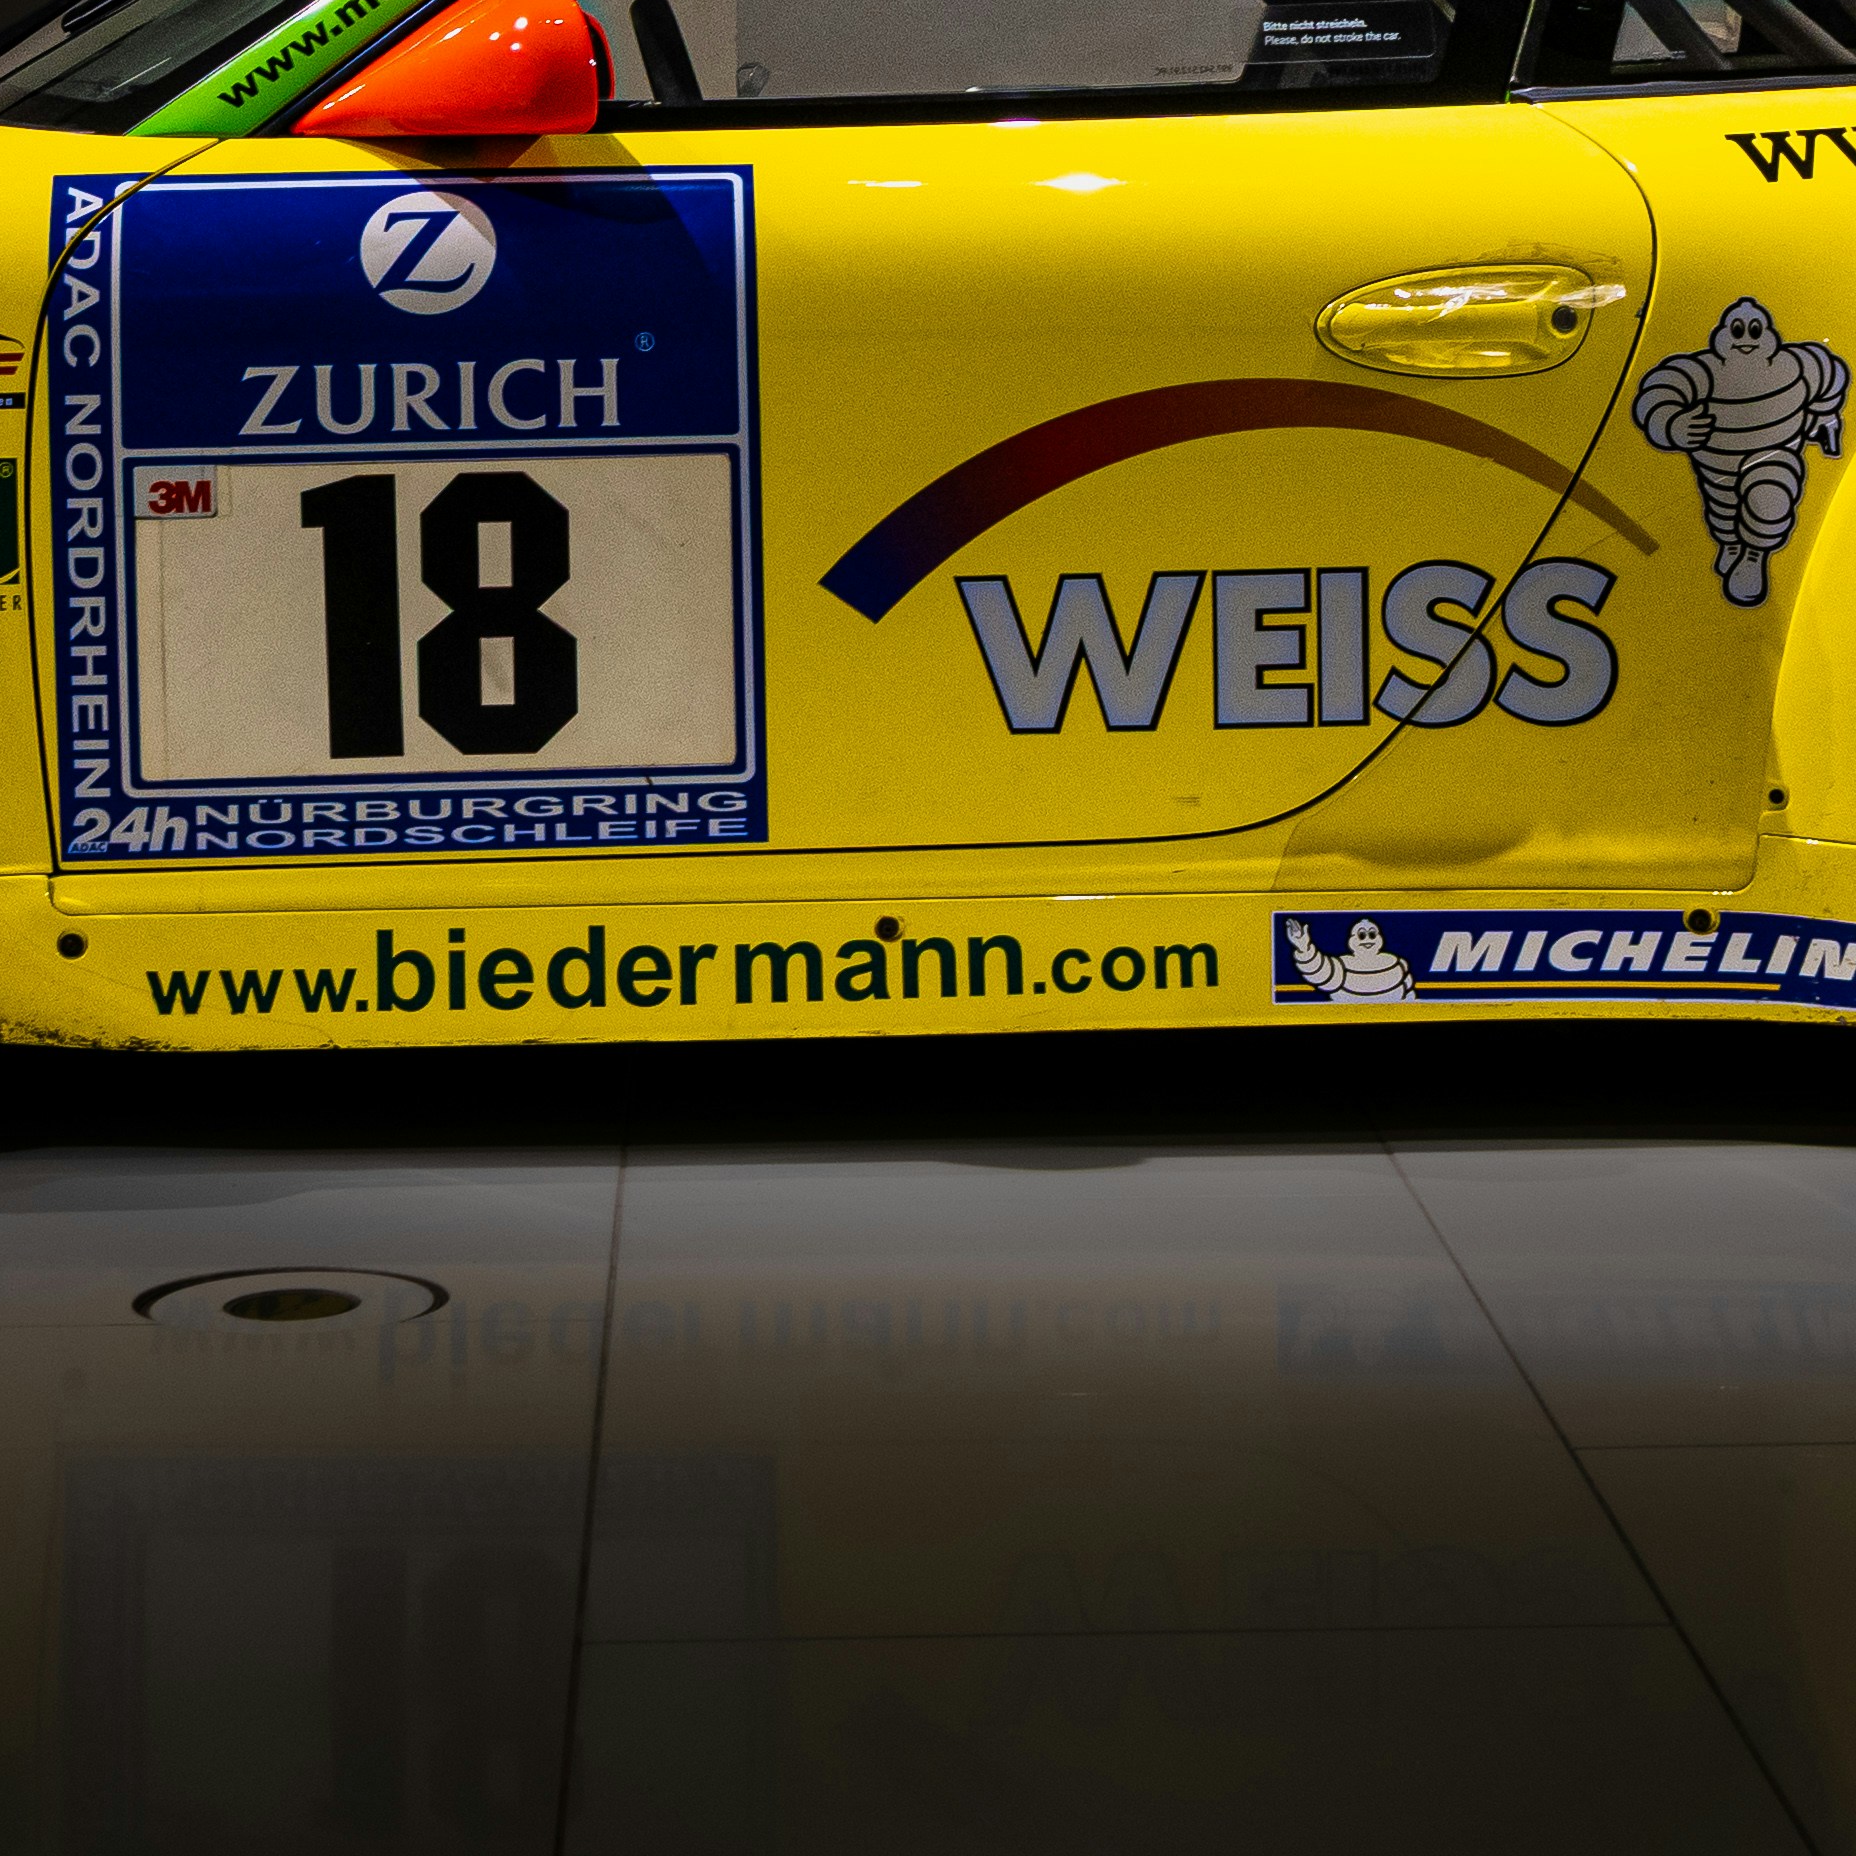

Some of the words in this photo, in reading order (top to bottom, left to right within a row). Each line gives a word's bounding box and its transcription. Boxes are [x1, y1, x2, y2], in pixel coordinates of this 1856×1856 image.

[1263, 21, 1288, 32] Bitte
[1289, 20, 1315, 30] nicht
[1316, 18, 1368, 29] streicheln.
[1264, 34, 1299, 46] Please,
[1300, 33, 1314, 44] do
[1315, 33, 1332, 43] not
[1333, 32, 1364, 42] stroke
[1365, 31, 1382, 41] the
[1383, 32, 1402, 41] car.
[63, 186, 102, 368] ADAC
[239, 358, 621, 436] ZURICH
[148, 480, 211, 514] 3M
[64, 393, 111, 798] NORDRHEIN
[300, 472, 578, 759] 18
[953, 556, 1619, 737] WEISS
[72, 805, 189, 853] 24h
[195, 791, 749, 826] NÜRBURGRING
[195, 818, 749, 850] NORDSCHLEIFE
[147, 927, 1220, 1016] www.biedermann.com
